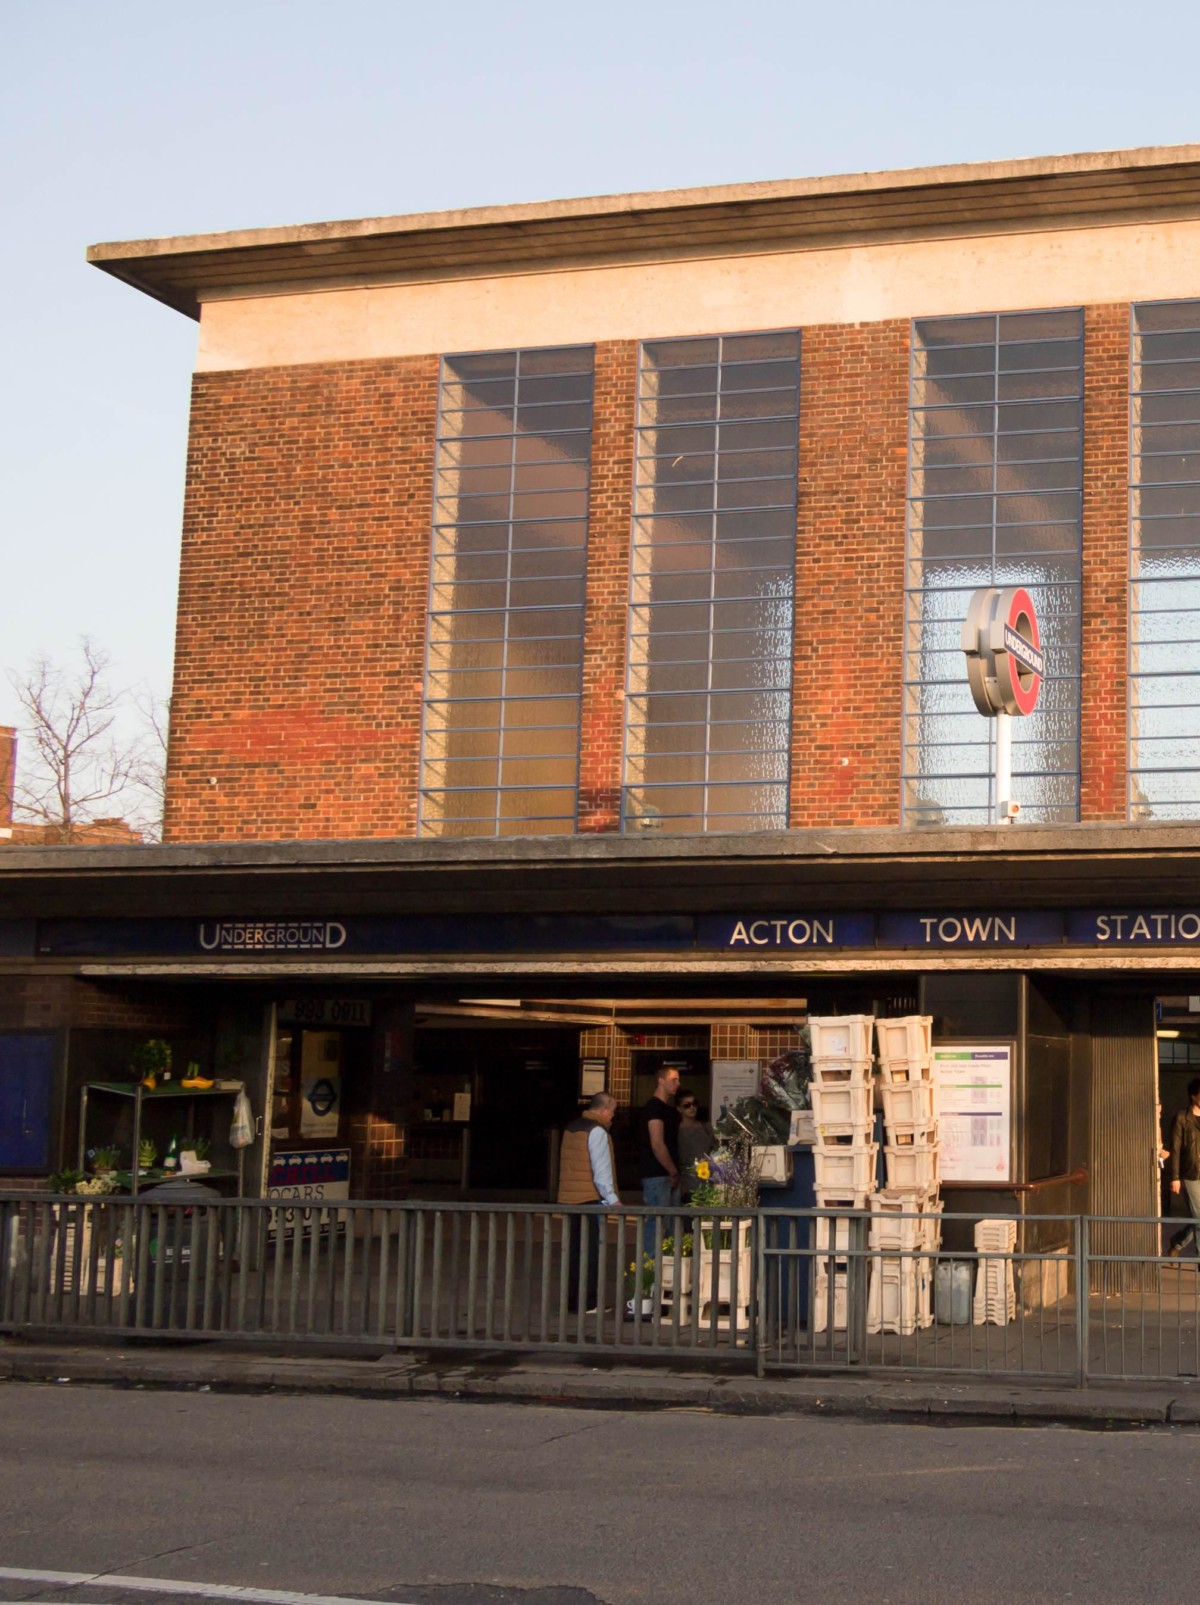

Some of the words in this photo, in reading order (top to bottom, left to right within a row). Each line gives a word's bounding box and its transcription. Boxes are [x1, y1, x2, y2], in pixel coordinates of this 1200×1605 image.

[1004, 628, 1043, 672] UNDERGROUND
[200, 922, 347, 949] UNDERGROUND
[729, 919, 834, 945] ACTON
[919, 917, 1016, 942] TOWN
